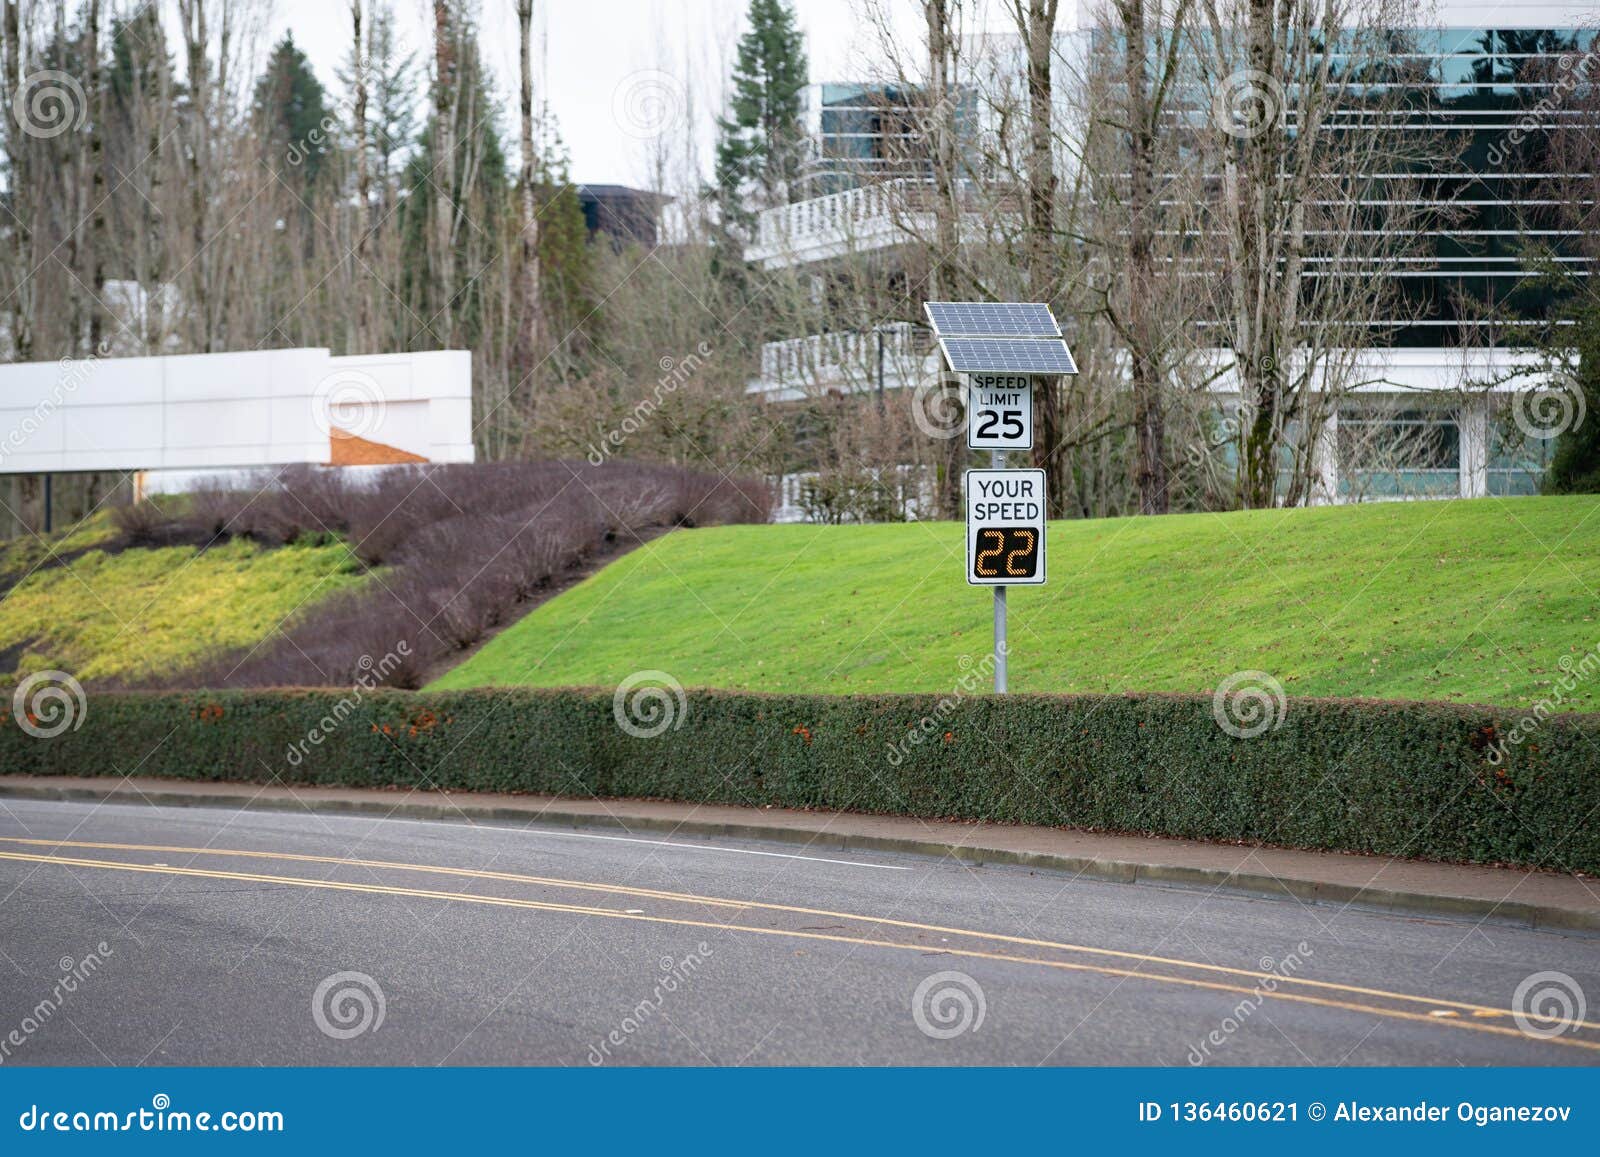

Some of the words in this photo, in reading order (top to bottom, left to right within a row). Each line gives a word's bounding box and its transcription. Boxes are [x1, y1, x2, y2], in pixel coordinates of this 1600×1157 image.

[975, 376, 1026, 389] SPEED
[981, 393, 1020, 405] LIMIT
[977, 410, 1024, 439] 25
[978, 480, 1033, 498] YOUR
[975, 503, 1039, 521] SPEED
[977, 530, 1034, 575] 22
